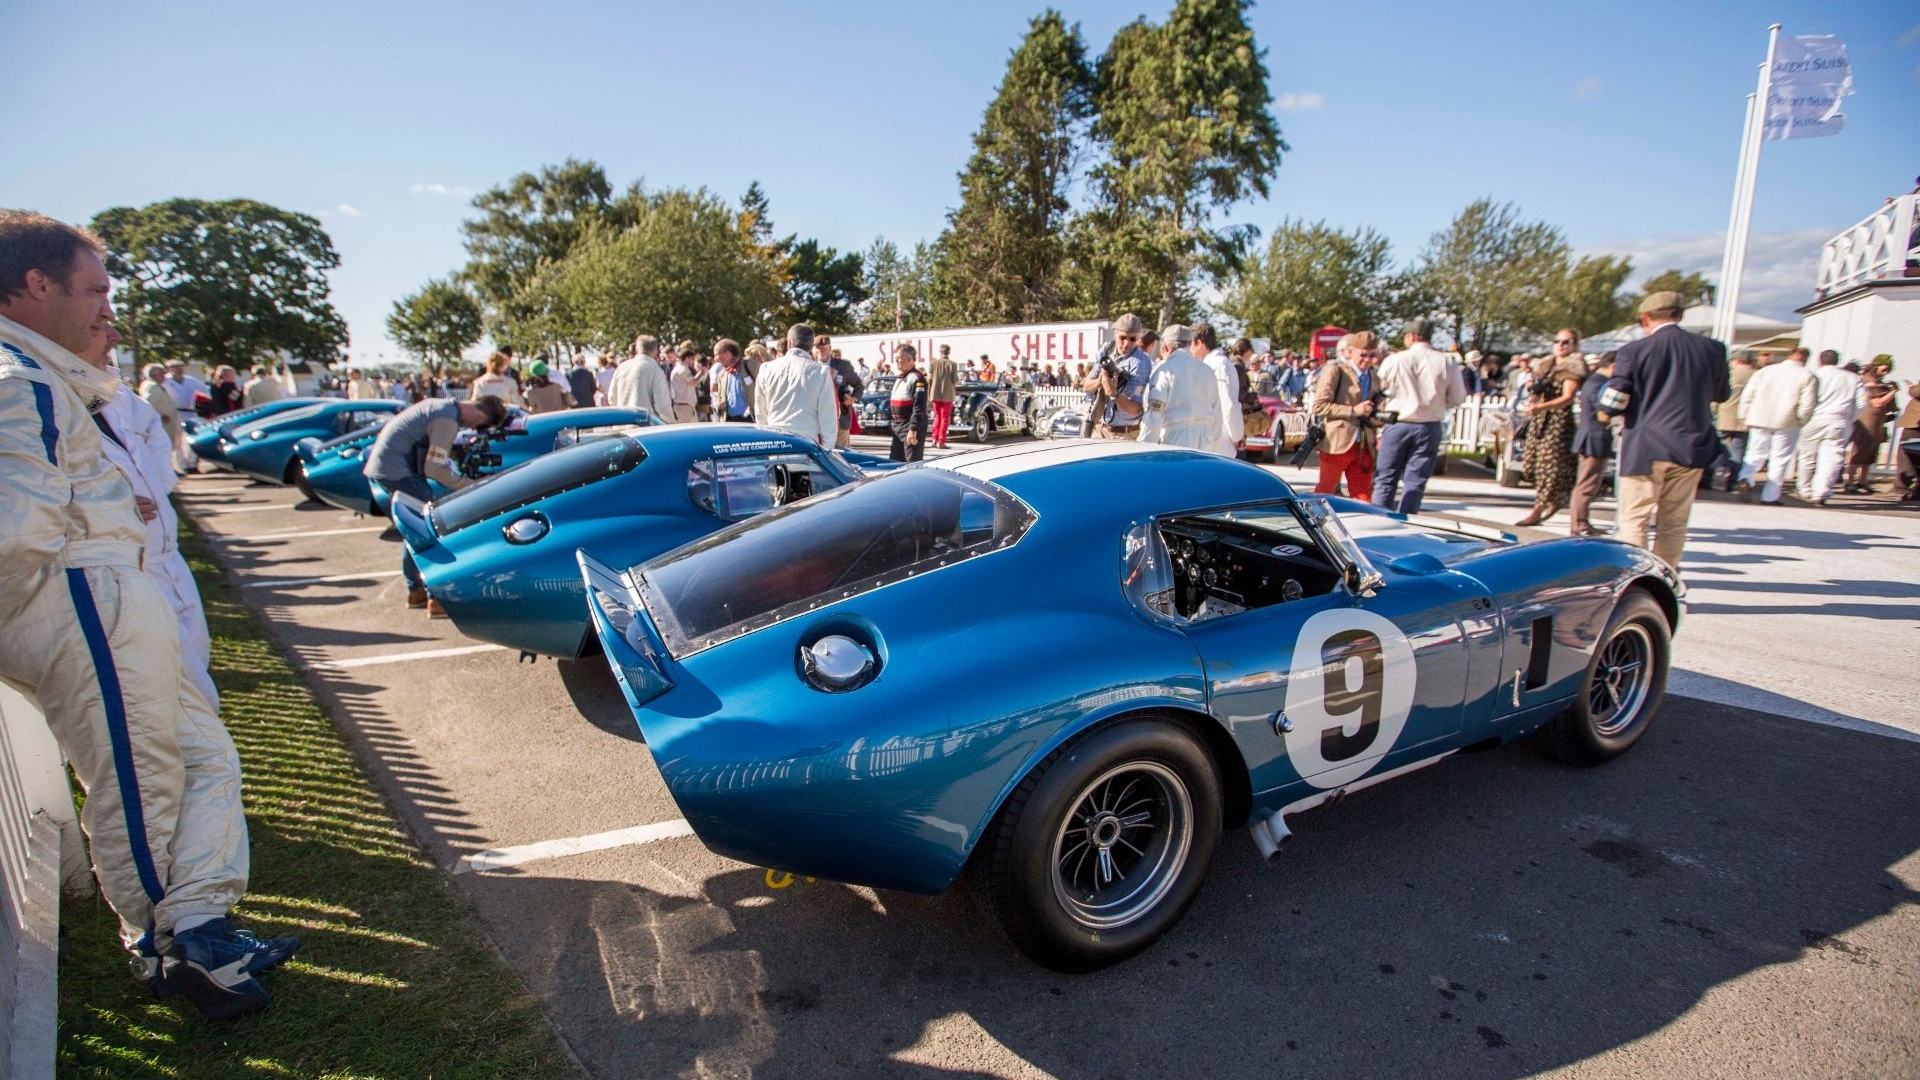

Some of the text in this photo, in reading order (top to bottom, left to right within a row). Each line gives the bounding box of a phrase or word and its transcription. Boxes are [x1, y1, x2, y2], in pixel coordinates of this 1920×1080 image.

[879, 338, 936, 363] SHLL
[1011, 332, 1089, 361] SHELL
[1320, 629, 1384, 762] 9
